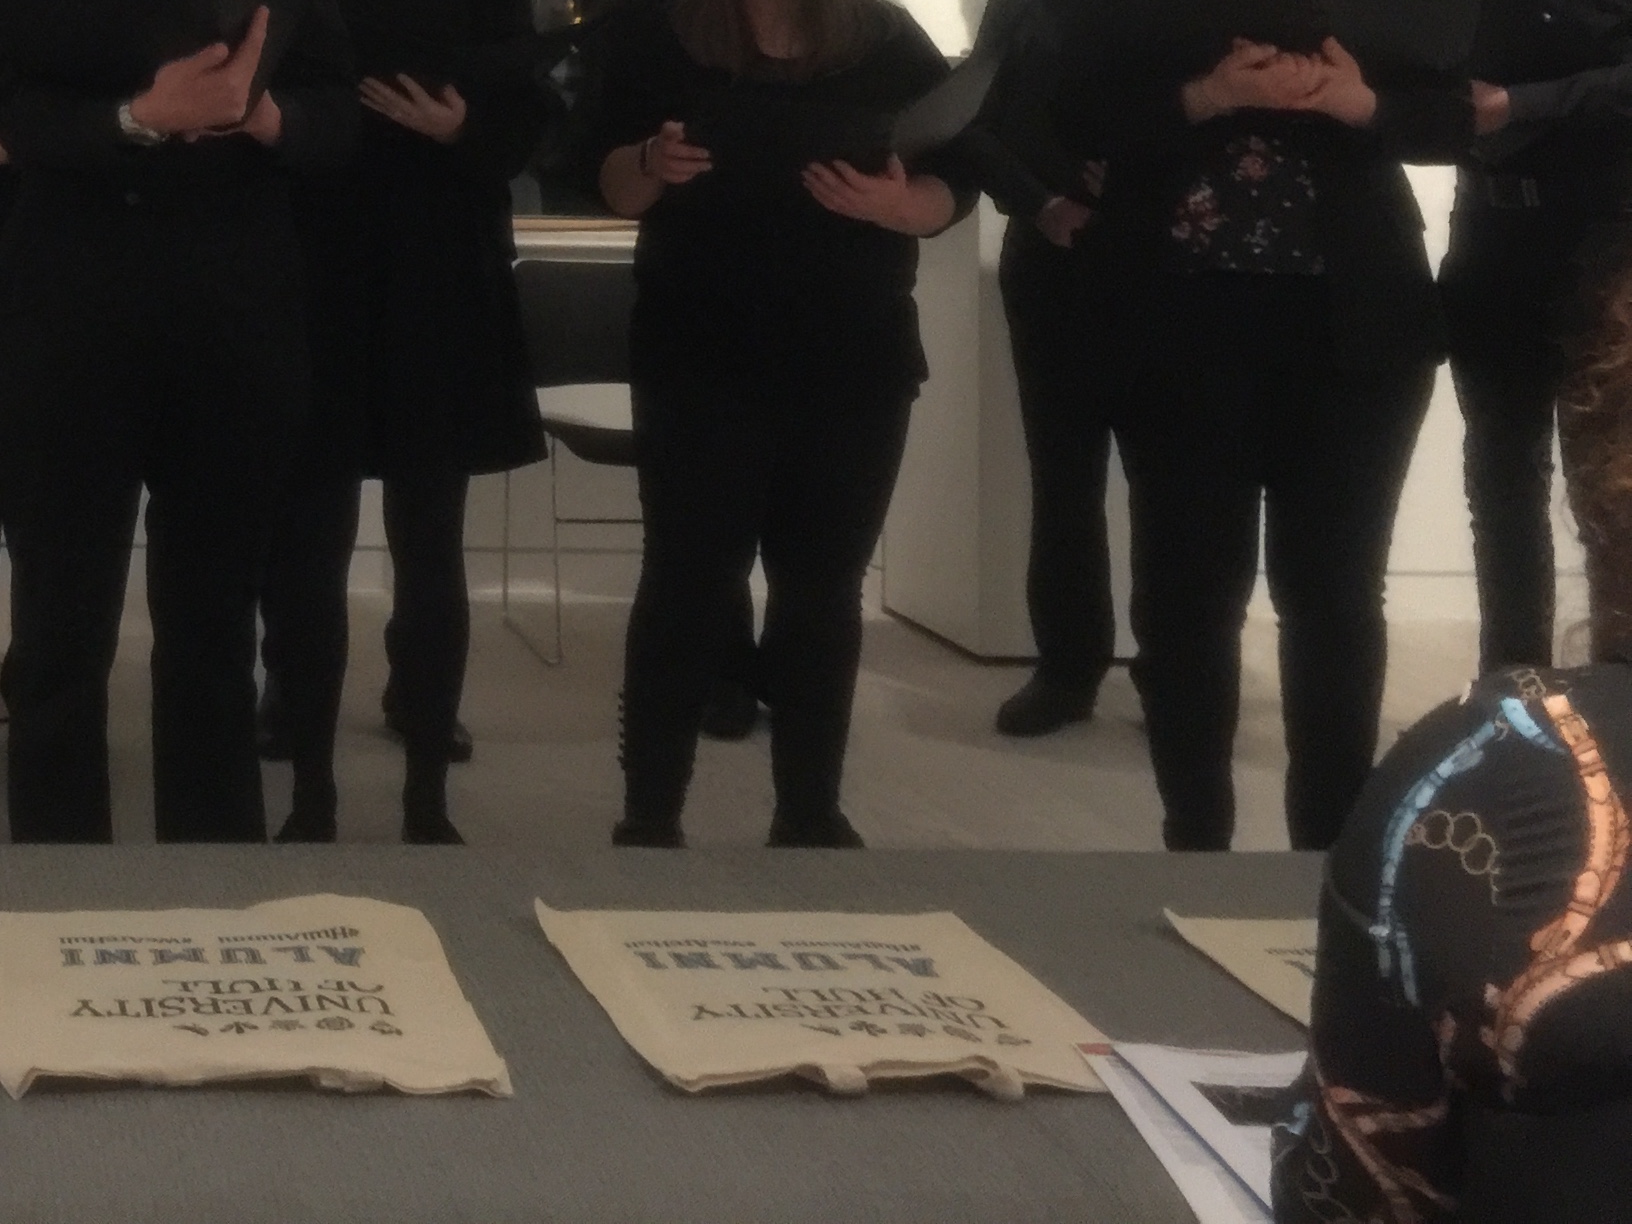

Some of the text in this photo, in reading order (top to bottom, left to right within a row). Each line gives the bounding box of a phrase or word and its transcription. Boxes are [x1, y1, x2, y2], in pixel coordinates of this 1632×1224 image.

[62, 946, 366, 967] ALUMNI
[634, 950, 941, 978] ALUMNI
[70, 994, 395, 1018] UNIVERSITY
[762, 986, 986, 1013] OF HULL
[692, 1002, 1010, 1029] UNIVERSITY
